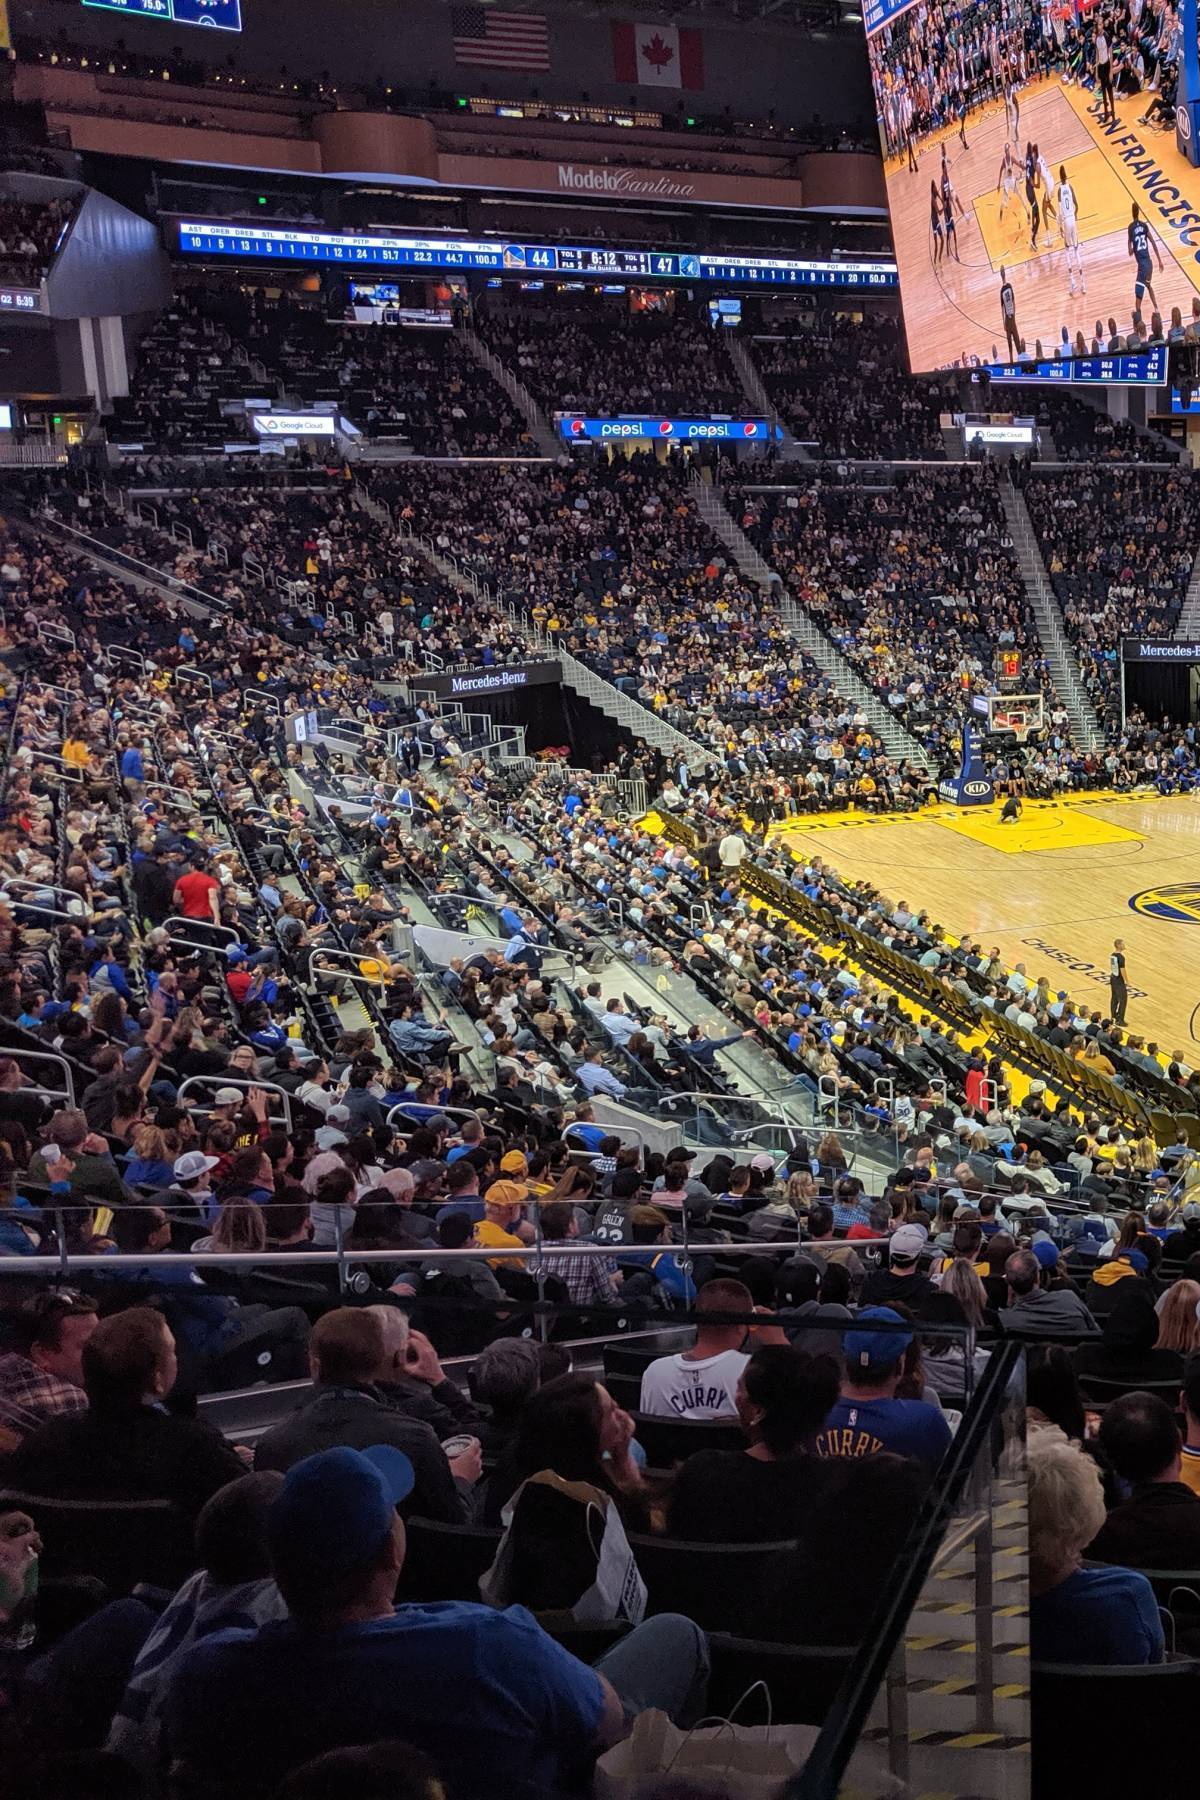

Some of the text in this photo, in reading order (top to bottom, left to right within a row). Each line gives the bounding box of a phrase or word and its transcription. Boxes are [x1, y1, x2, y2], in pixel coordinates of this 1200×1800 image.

[1086, 99, 1121, 144] SAN
[558, 165, 696, 196] Modelo Cantina
[1135, 235, 1147, 251] 23
[191, 237, 497, 264] 10 5 13 5 1 7 12 24 51.7 22.2 44.7 100.0
[532, 252, 549, 265] 44
[577, 261, 583, 270] 2
[591, 252, 616, 265] 6:12
[657, 257, 672, 272] 47
[640, 264, 646, 272] 3
[708, 267, 716, 276] 11
[730, 268, 736, 277] 8
[749, 269, 758, 278] 12
[790, 271, 796, 280] 2
[810, 272, 816, 282] 9
[830, 273, 835, 282] 3
[848, 274, 858, 282] 20
[869, 274, 886, 284] 50.0
[1, 295, 34, 307] Q2 6:39
[280, 421, 304, 430] Google
[602, 422, 640, 436] pepsi
[689, 424, 726, 438] pepsi
[1006, 662, 1017, 675] 19
[452, 672, 526, 692] Mercedes-Benz
[939, 782, 959, 798] thrive
[968, 784, 986, 793] KIA
[1020, 938, 1080, 964] CHASE
[896, 1108, 910, 1117] 30
[602, 1214, 624, 1226] GREEN
[670, 1387, 728, 1414] CURRY
[816, 1428, 884, 1458] CURRY
